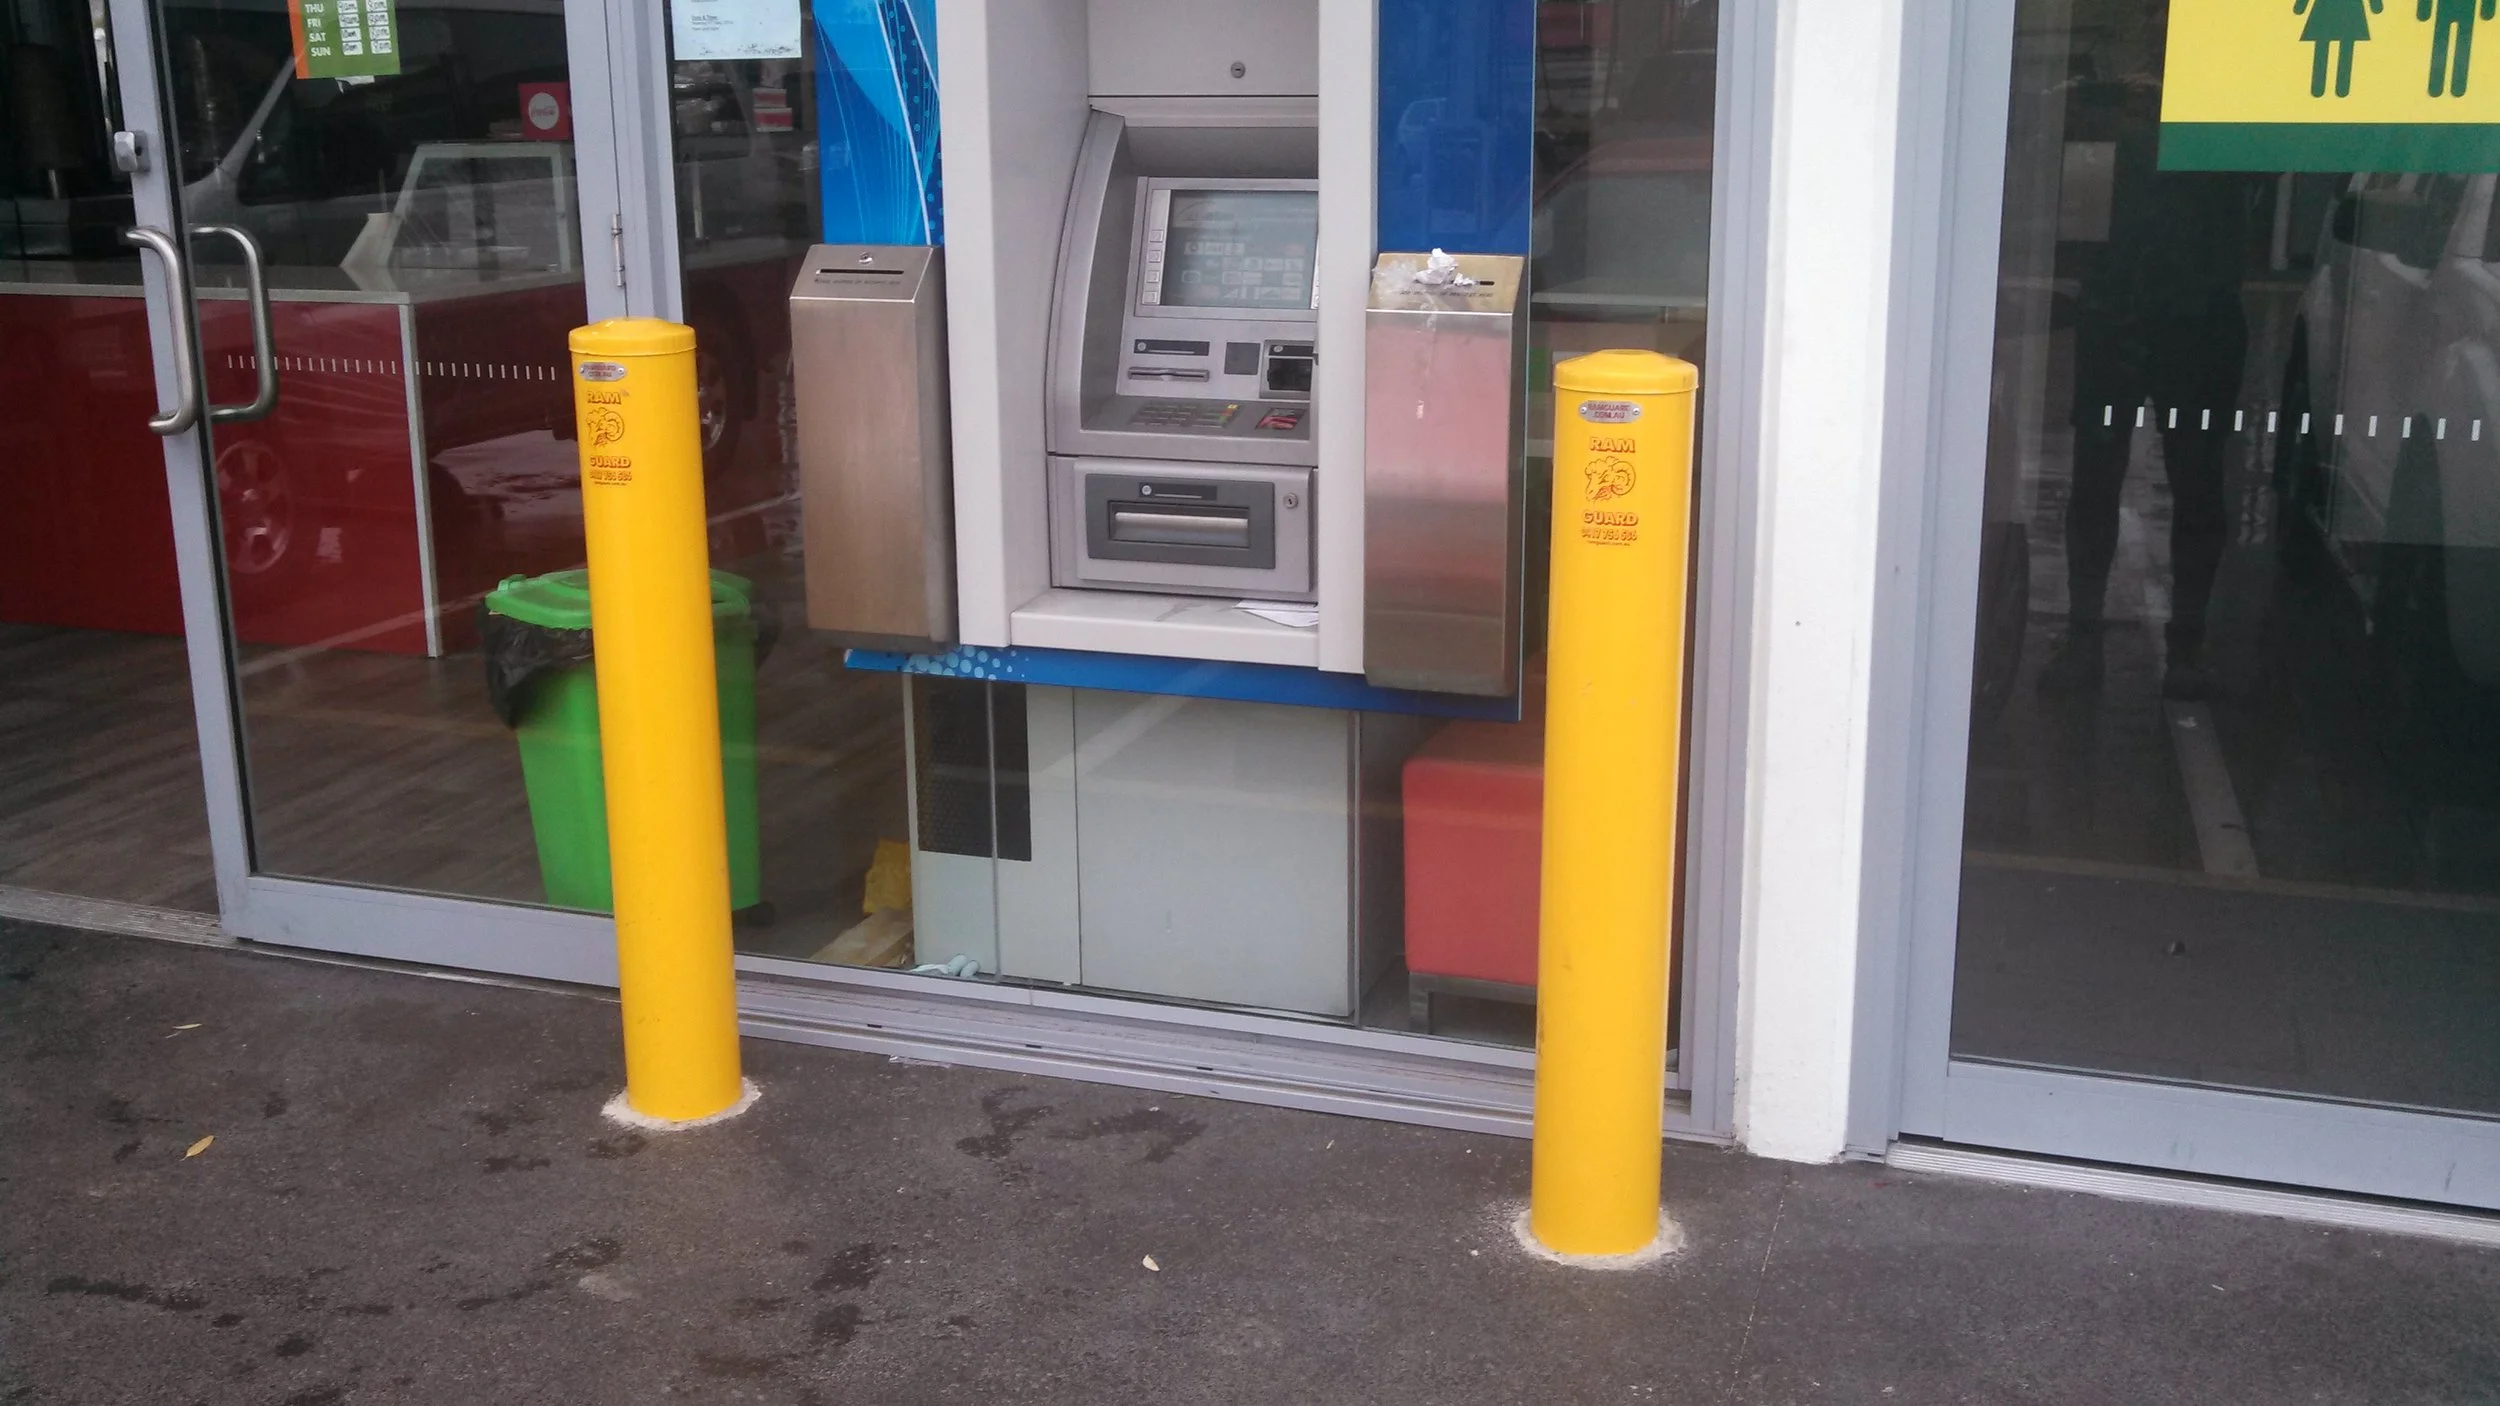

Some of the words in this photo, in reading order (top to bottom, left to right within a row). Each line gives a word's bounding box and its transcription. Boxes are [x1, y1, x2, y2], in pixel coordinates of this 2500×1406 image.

[304, 3, 324, 14] THU
[306, 18, 322, 29] FRI
[308, 32, 327, 43] SAT
[310, 46, 331, 57] SUN
[586, 391, 622, 404] RAM
[1589, 436, 1636, 453] RAM
[589, 455, 632, 469] GUARD
[1582, 510, 1639, 527] GUARD
